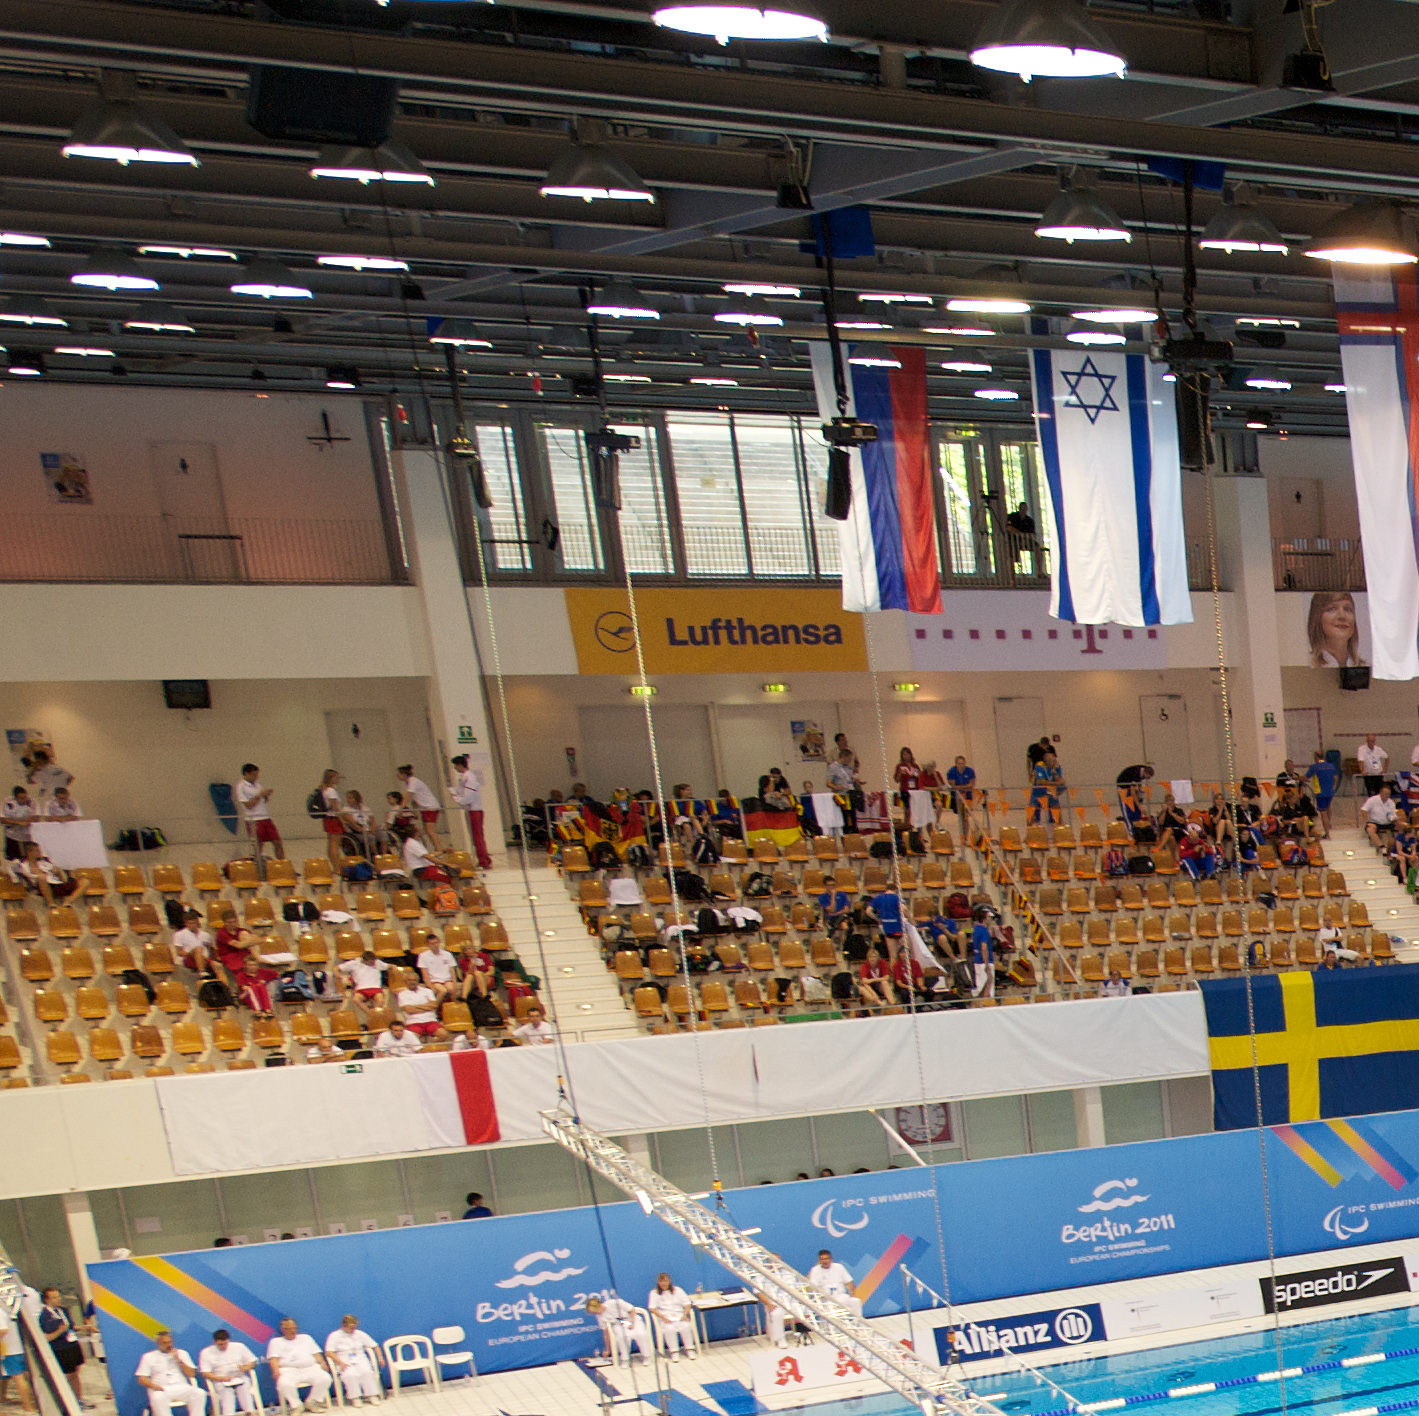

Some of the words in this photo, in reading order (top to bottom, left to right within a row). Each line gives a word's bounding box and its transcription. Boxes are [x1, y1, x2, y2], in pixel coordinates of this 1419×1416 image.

[665, 617, 843, 646] Lufthansa
[1134, 1213, 1176, 1234] 2011
[1273, 1271, 1357, 1306] speedo
[953, 1322, 1052, 1355] Allianz
